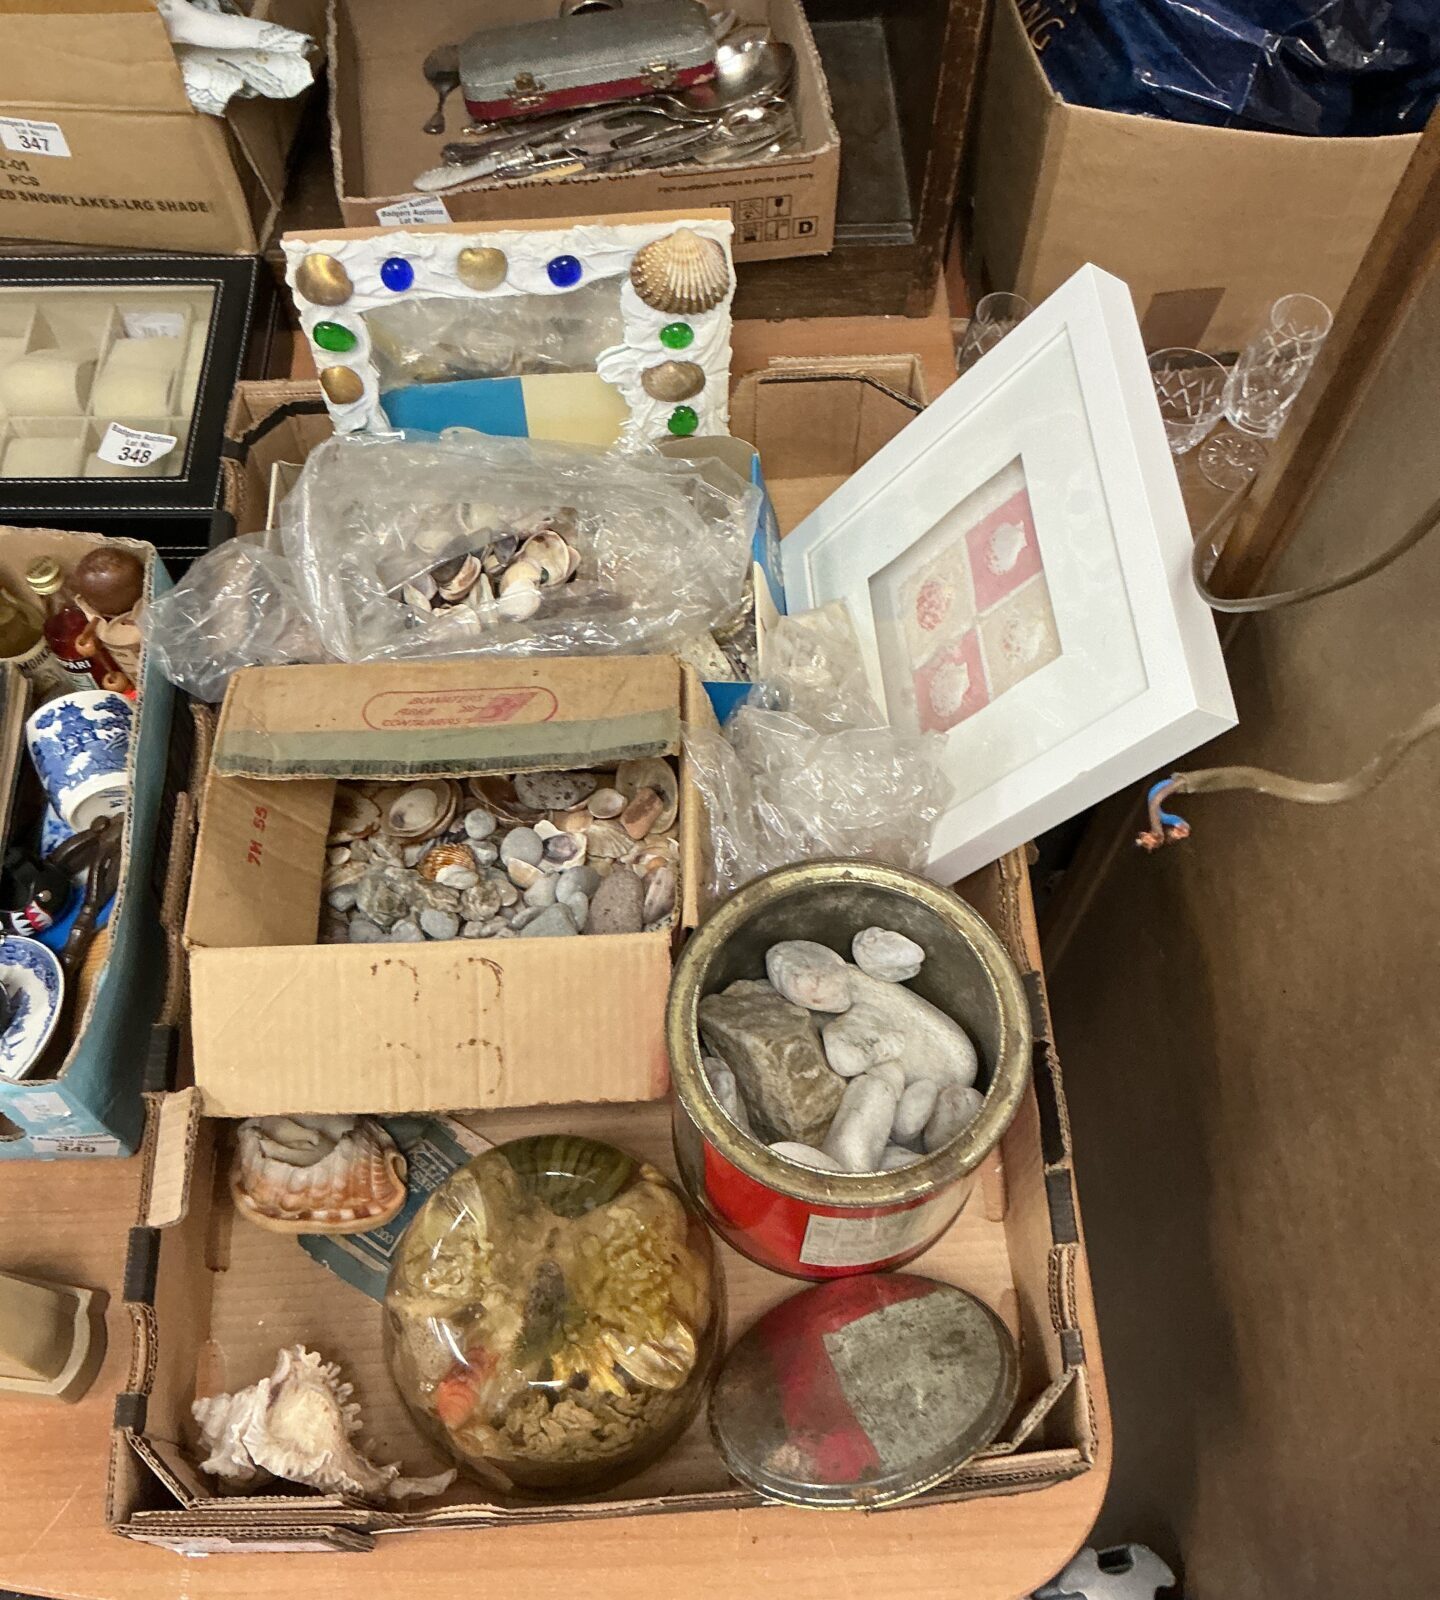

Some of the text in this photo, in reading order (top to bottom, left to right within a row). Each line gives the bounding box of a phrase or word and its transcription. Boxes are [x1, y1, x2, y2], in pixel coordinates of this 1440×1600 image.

[19, 135, 49, 151] 347
[8, 174, 40, 187] PCS
[156, 200, 209, 213] SHADE
[118, 446, 152, 464] 348
[56, 1145, 97, 1153] 349
